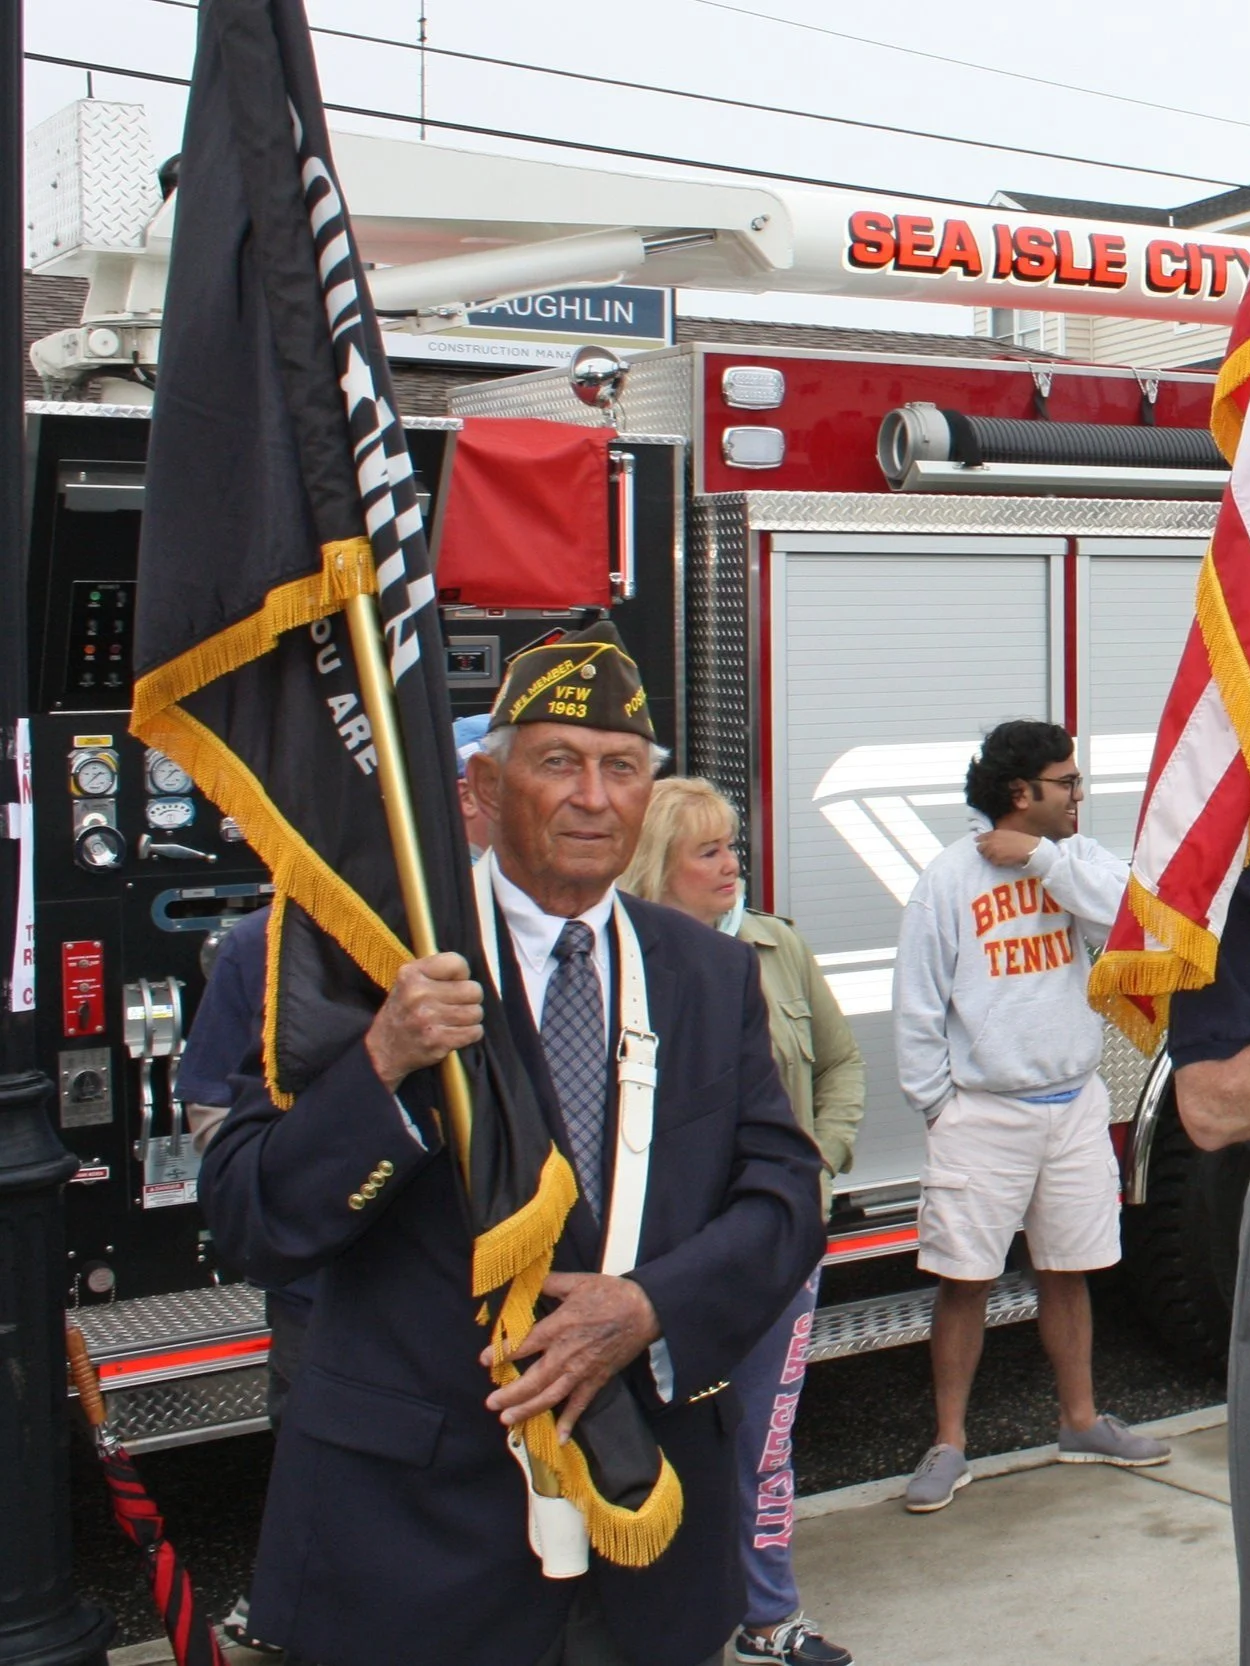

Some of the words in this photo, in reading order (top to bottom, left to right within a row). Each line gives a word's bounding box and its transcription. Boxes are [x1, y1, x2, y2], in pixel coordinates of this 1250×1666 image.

[848, 210, 983, 278] SEA
[991, 223, 1127, 289] ISLE
[479, 294, 634, 324] AUGHLIN
[428, 341, 529, 357] CONSTRUCTION
[527, 659, 574, 695] MEMBER
[555, 685, 592, 701] VFW
[327, 692, 379, 776] ARE
[548, 701, 588, 718] 1963
[984, 927, 1073, 978] TENNI
[780, 1309, 815, 1385] SEA
[757, 1393, 799, 1473] ISLE
[753, 1469, 794, 1549] CITY
